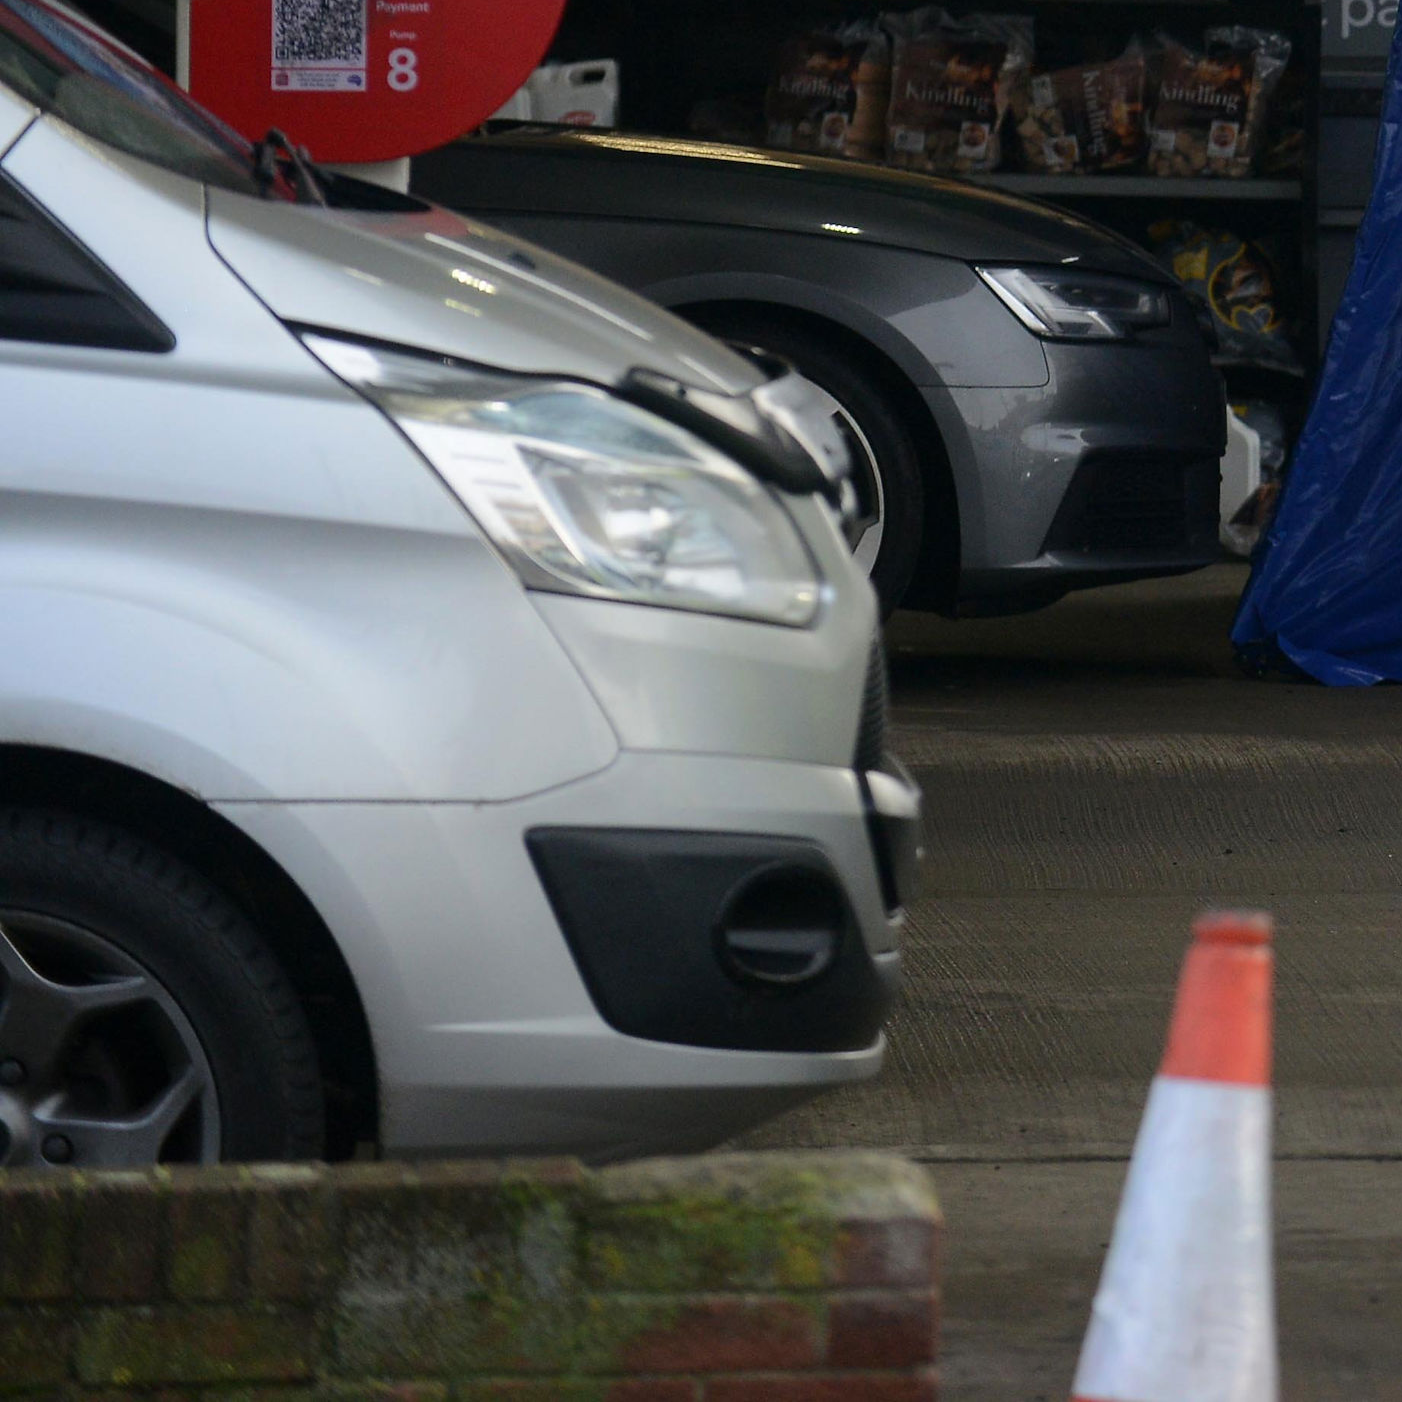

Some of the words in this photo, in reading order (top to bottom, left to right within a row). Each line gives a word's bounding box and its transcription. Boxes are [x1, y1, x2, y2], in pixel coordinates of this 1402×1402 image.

[376, 1, 430, 14] Payment
[390, 30, 417, 41] Pump
[387, 47, 418, 92] 8
[905, 79, 992, 114] Kindling
[1159, 79, 1242, 112] Kindling
